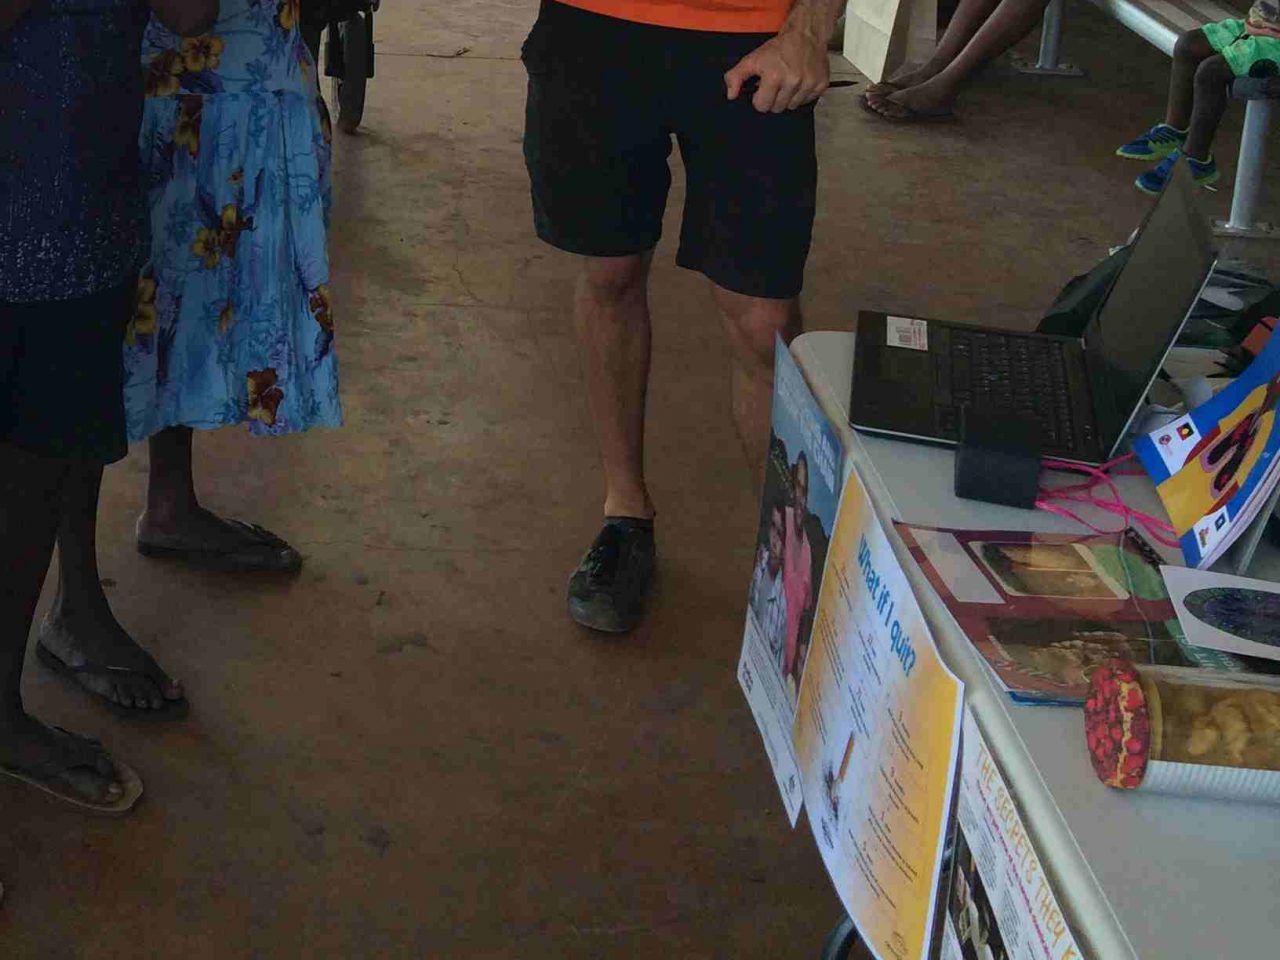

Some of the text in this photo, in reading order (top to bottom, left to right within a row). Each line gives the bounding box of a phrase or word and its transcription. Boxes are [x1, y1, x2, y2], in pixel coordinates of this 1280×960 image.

[858, 533, 917, 678] What if I quit?
